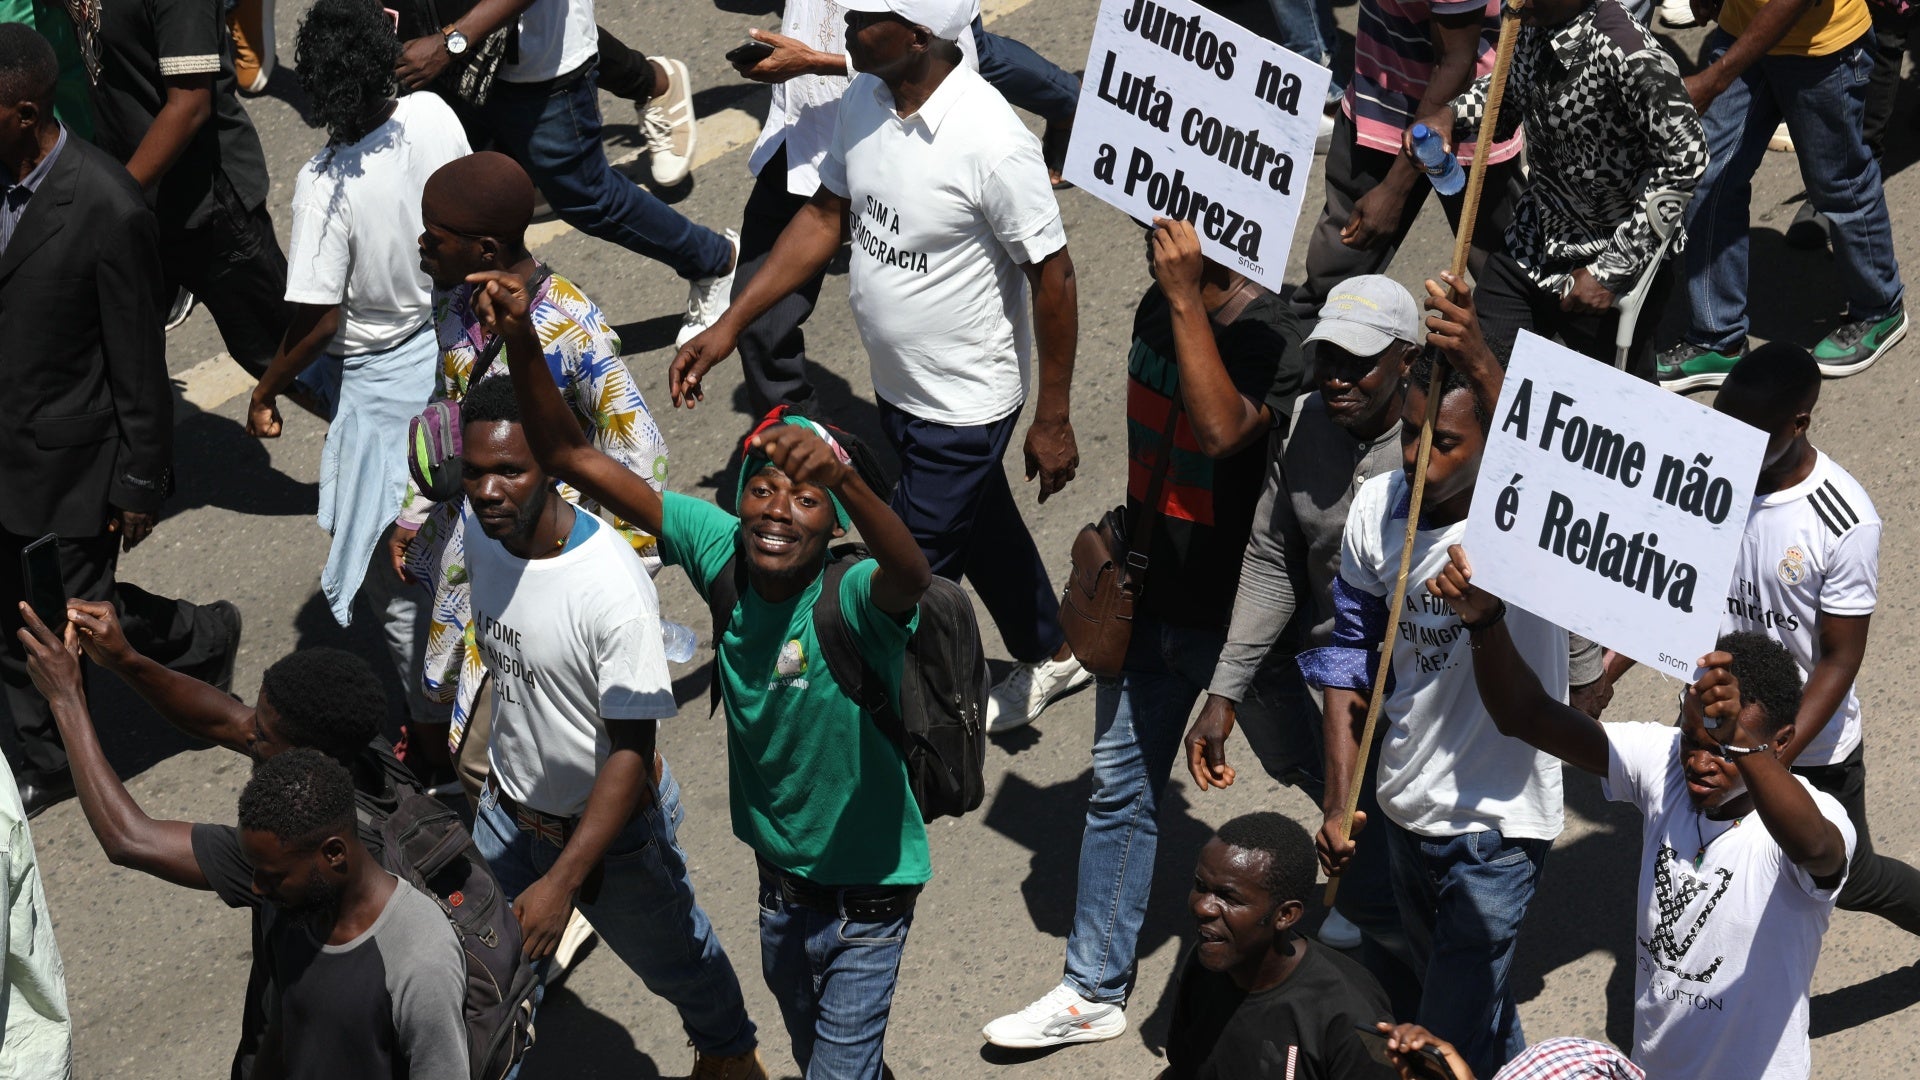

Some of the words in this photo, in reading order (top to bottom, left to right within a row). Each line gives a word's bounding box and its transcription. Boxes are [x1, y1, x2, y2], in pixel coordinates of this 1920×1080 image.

[1124, 0, 1237, 81] Juntos
[1255, 60, 1302, 116] na
[1097, 50, 1173, 133] Luta
[1181, 107, 1294, 196] contra
[867, 195, 888, 227] SIM
[890, 207, 900, 235] À
[1093, 143, 1117, 185] a
[1123, 146, 1263, 262] Pobreza
[1238, 255, 1265, 276] sncm
[1502, 378, 1533, 441] A
[1539, 391, 1646, 488] Fome
[1653, 453, 1733, 524] não
[1495, 473, 1523, 532] é
[1538, 490, 1698, 613] Relativa
[486, 616, 521, 652] FOME
[1406, 595, 1418, 612] A
[1658, 652, 1688, 672] sncm
